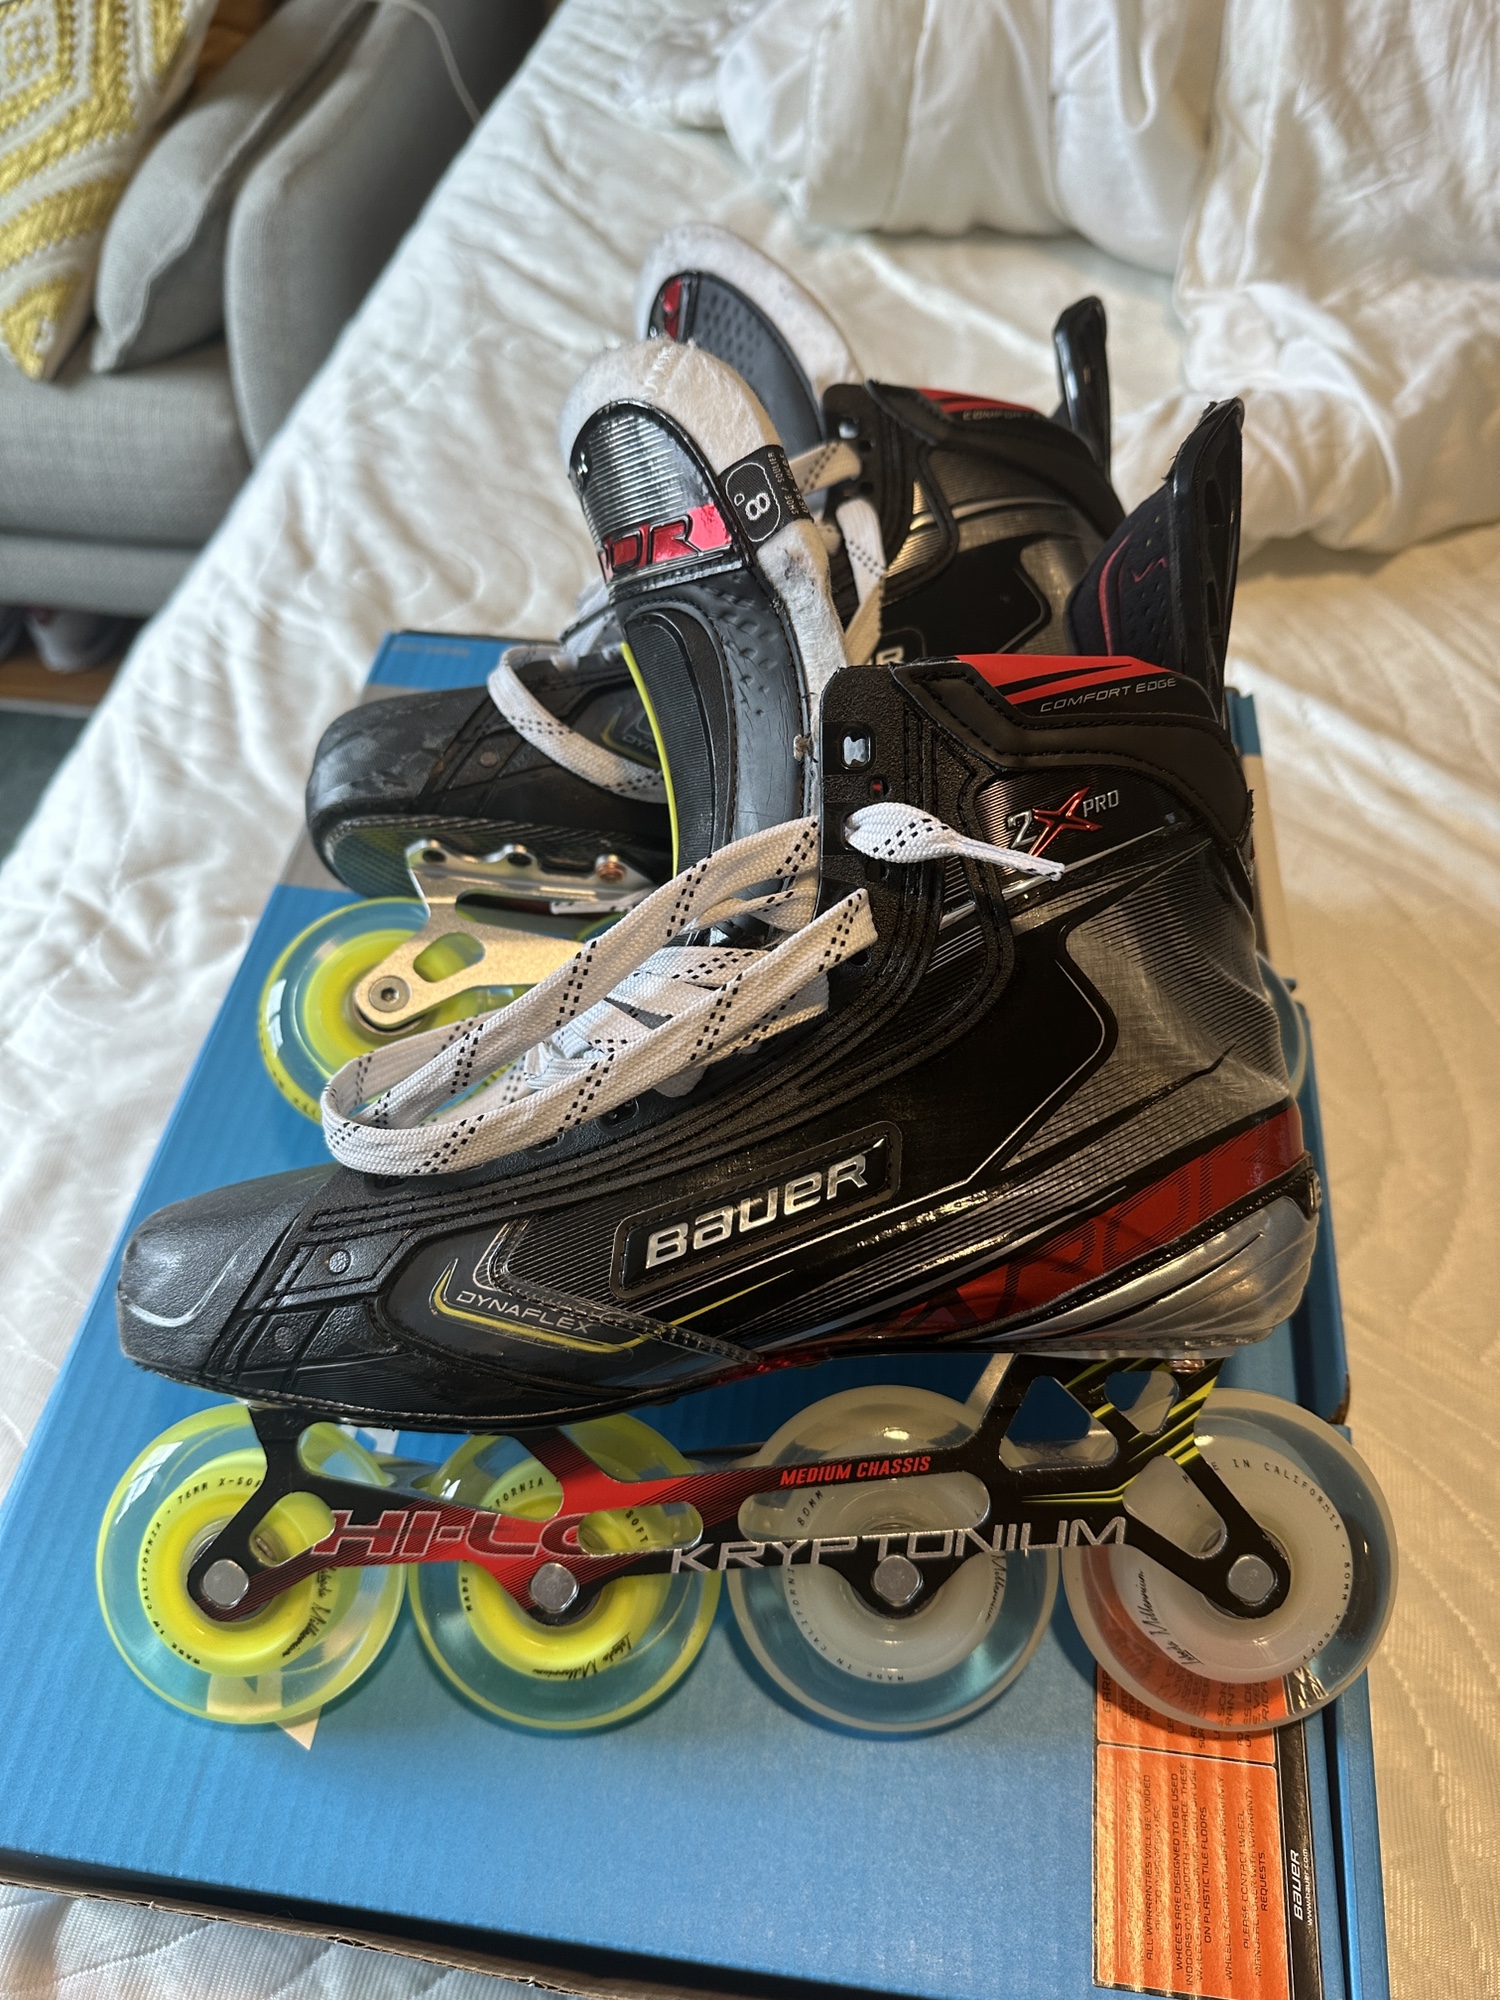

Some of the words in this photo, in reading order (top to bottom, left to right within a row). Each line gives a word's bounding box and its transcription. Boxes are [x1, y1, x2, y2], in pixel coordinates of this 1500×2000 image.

[1039, 685, 1132, 713] COMFORT
[1135, 677, 1178, 694] EDGE
[1082, 789, 1120, 818] PRO
[645, 1153, 868, 1270] BAUER
[456, 1290, 596, 1335] DYNAFLEX
[218, 1476, 263, 1489] X-SOF
[779, 1464, 852, 1486] MEDIUM
[856, 1456, 932, 1478] CHASSIS
[797, 1489, 824, 1526] 80MM
[1232, 1458, 1251, 1469] IN
[1263, 1461, 1341, 1532] CALIFORNIA
[625, 1508, 650, 1544] SOFT
[671, 1515, 1127, 1574] KRYPTONIUM
[142, 1521, 163, 1610] CALIFORNIA
[787, 1567, 828, 1652] CALIFORNI
[1143, 1775, 1151, 1813] VOIDED
[1172, 1805, 1179, 1818] BE
[1144, 1817, 1151, 1830] BE
[1172, 1821, 1179, 1835] TO
[1173, 1838, 1181, 1894] DESIGNED
[1182, 1852, 1191, 1899] SMOOTH
[1201, 1852, 1209, 1875] TILE
[1290, 1849, 1303, 1920] BAUER
[1145, 1861, 1153, 1935] WARRANTIES
[1202, 1878, 1211, 1923] PLASTIC
[1303, 1848, 1312, 1925] www.bauer.com
[1184, 1913, 1191, 1930] ON
[1204, 1926, 1212, 1943] ON
[1175, 1923, 1183, 1971] WHEELS
[1185, 1933, 1193, 1986] INDOORS
